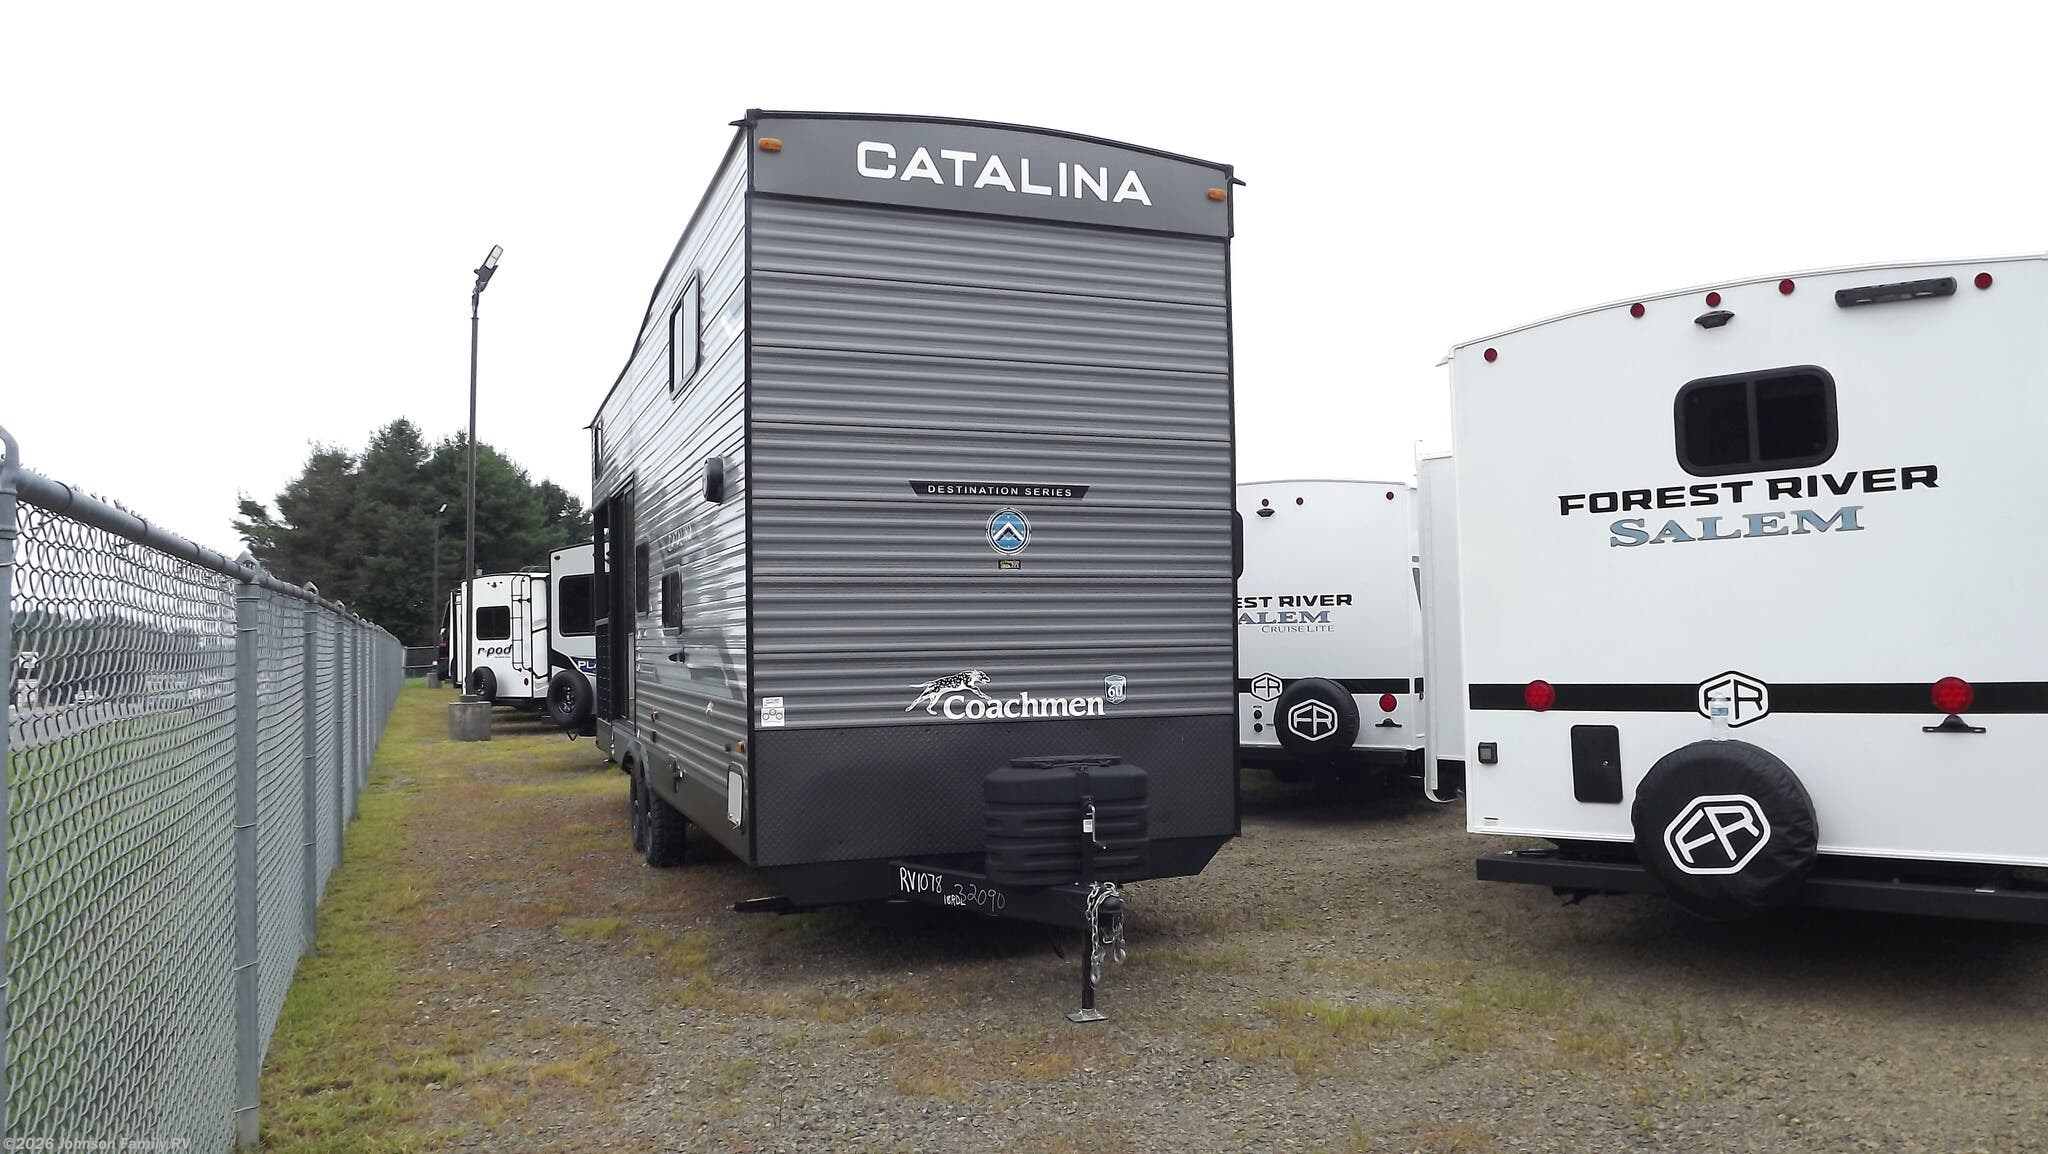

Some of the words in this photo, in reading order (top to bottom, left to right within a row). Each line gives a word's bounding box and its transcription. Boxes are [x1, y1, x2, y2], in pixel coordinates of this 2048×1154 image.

[857, 140, 1152, 206] CATALINA
[927, 484, 1019, 496] DESTINATION
[1024, 487, 1073, 498] SERIES
[1557, 480, 1754, 516] FOREST
[1764, 464, 1940, 501] RIVER
[1609, 505, 1865, 549] SALEM
[1278, 594, 1353, 608] RIVER
[1238, 610, 1331, 625] ALEM
[943, 691, 1106, 720] Coachmen
[899, 866, 943, 894] RV1078
[953, 883, 1006, 912] 32090
